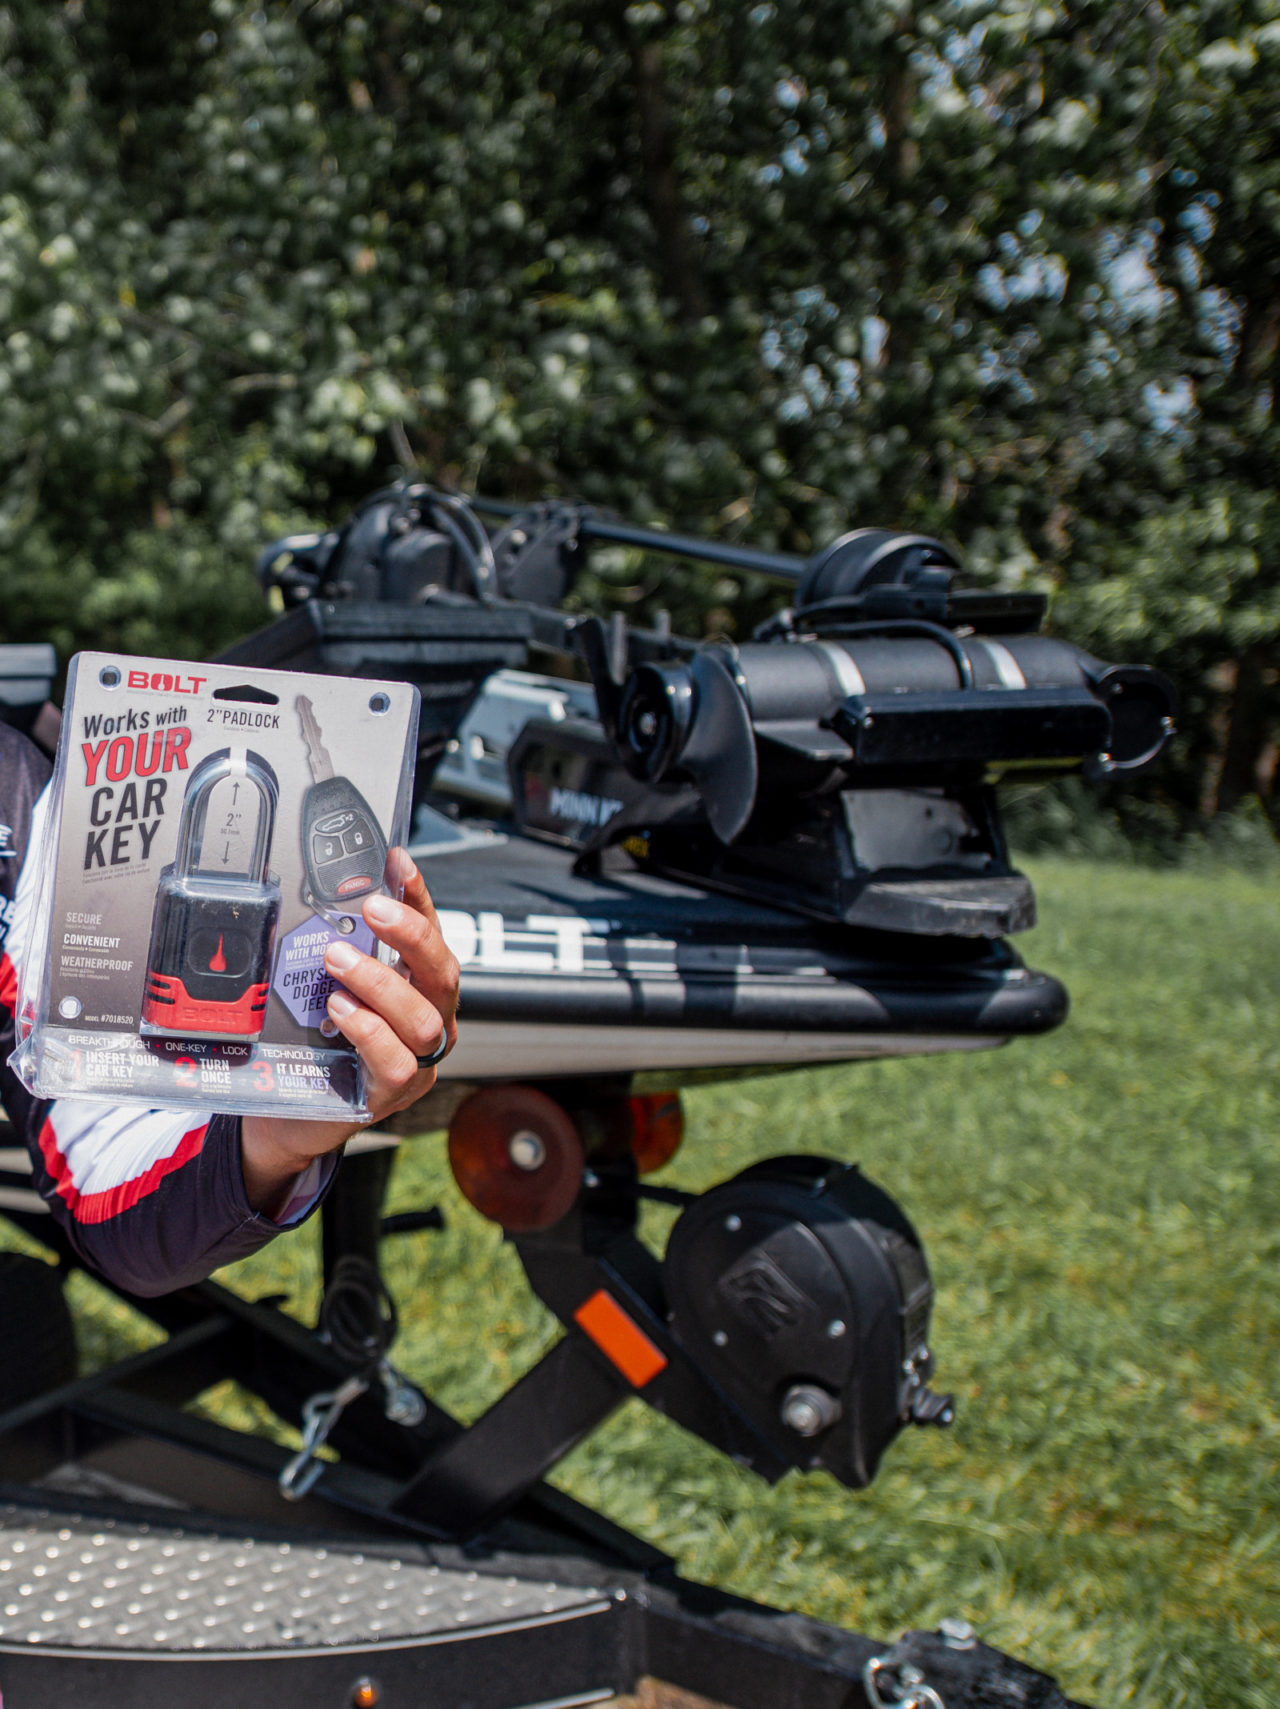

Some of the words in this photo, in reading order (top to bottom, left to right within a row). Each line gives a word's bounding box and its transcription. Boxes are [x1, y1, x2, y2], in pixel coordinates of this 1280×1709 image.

[127, 671, 207, 694] BOLT
[83, 708, 150, 738] Works
[156, 705, 187, 726] with
[81, 726, 192, 786] YOUR
[90, 777, 167, 827] CAR
[84, 819, 161, 870] KEY
[344, 879, 365, 890] PANIC
[66, 912, 102, 925] SECURE
[63, 933, 120, 948] CONVENIENT
[293, 931, 329, 948] WORKS
[286, 948, 309, 961] WITH
[61, 955, 134, 971] WEATHERPROOF
[283, 967, 334, 987] CHRYS
[293, 979, 335, 1000] DODGE
[101, 1014, 134, 1024] #7018520
[86, 1051, 126, 1065] INSERT
[130, 1054, 160, 1067] YOUR
[165, 1042, 207, 1053] ONE-KEY
[222, 1045, 248, 1056] LOCK
[262, 1048, 326, 1061] TECHNOLOGY
[86, 1064, 109, 1077] CAR
[112, 1066, 134, 1078] KEY
[174, 1056, 198, 1088] 2
[200, 1058, 229, 1071] TURN
[277, 1063, 289, 1074] IT
[290, 1063, 331, 1078] LEARNS
[201, 1070, 232, 1084] ONCE
[251, 1061, 275, 1092] 3
[279, 1076, 308, 1089] YOUR
[310, 1078, 330, 1090] KEY
